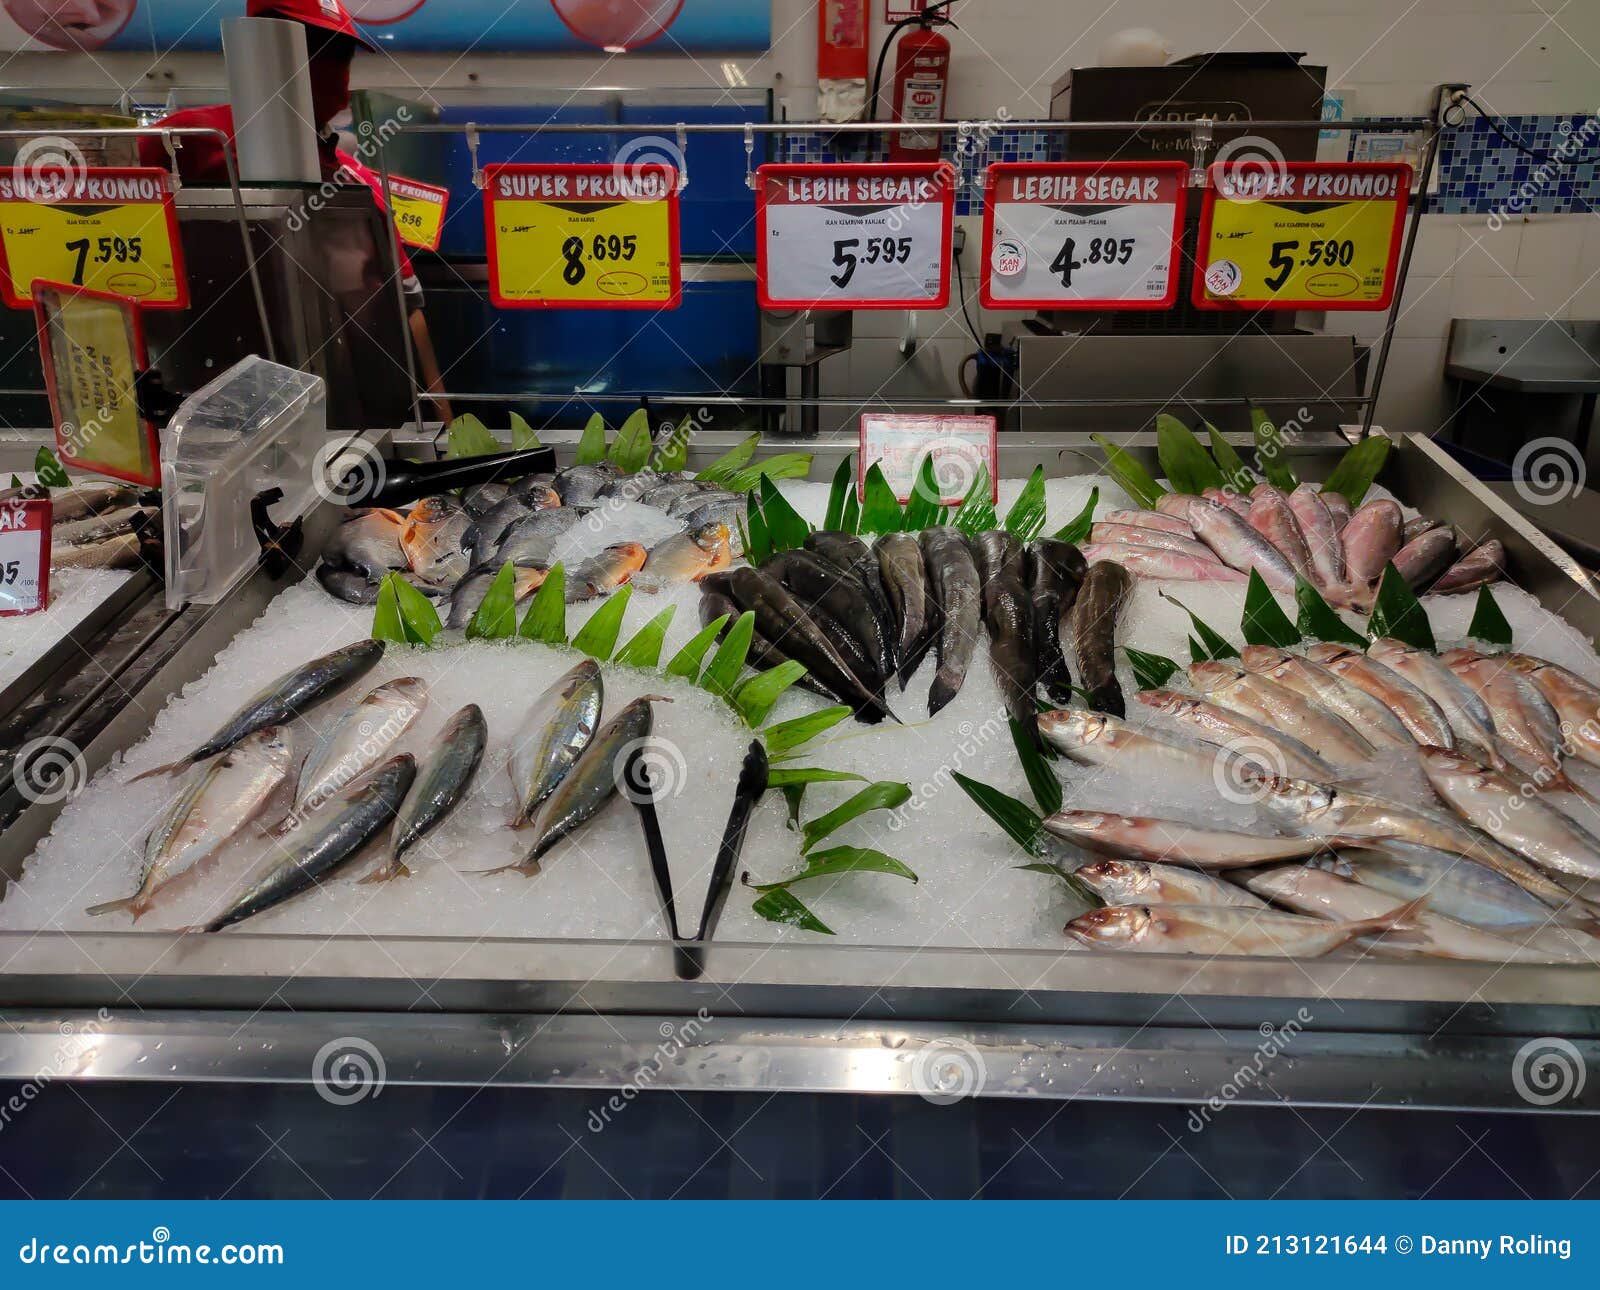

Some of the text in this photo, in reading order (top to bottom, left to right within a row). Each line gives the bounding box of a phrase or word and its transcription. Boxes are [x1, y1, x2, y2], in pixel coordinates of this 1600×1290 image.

[0, 178, 162, 199] SUPER PROMO!
[499, 174, 666, 197] SUPER PROMO!
[788, 177, 930, 201] LEBIH SEGAR
[1012, 176, 1160, 200] LEBIH SEGAR
[1223, 173, 1398, 197] SUPER PROMO!
[66, 237, 142, 286] 7.595
[562, 234, 637, 286] 8.695
[830, 237, 913, 289] 5.595
[1049, 237, 1136, 288] 4.895
[1264, 239, 1354, 292] 5.590
